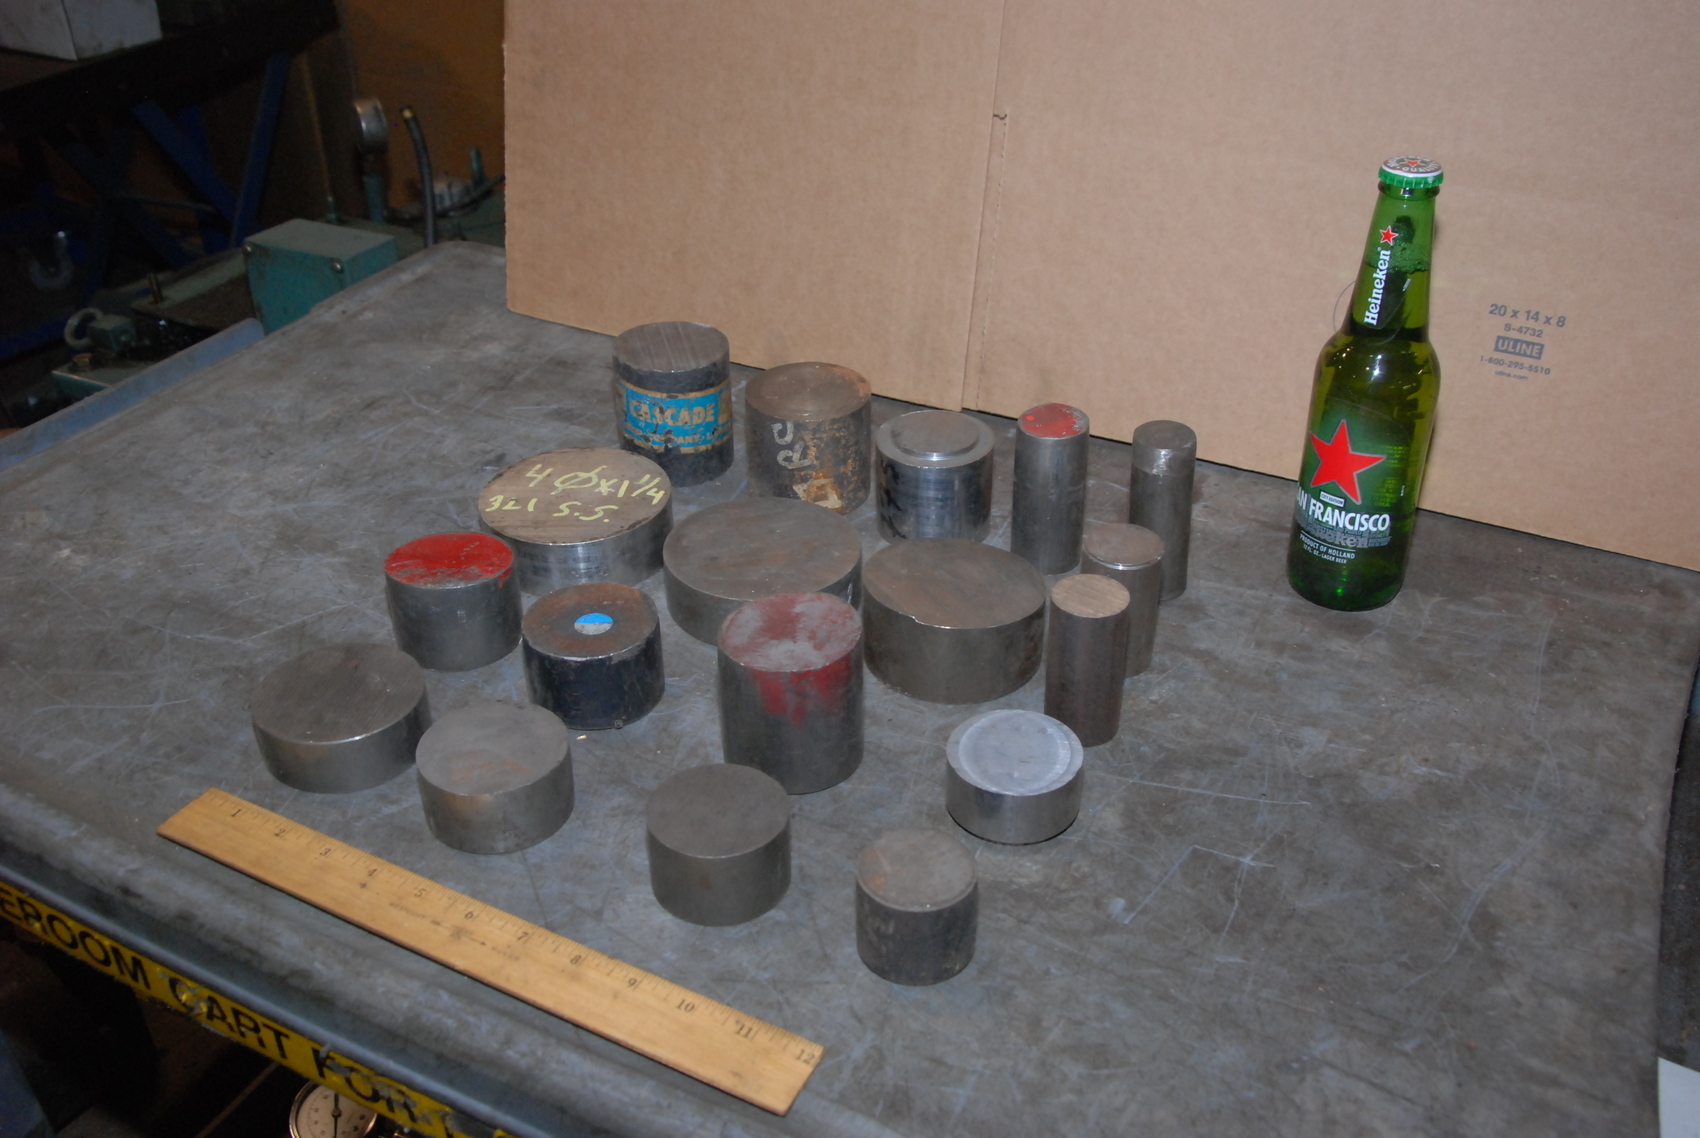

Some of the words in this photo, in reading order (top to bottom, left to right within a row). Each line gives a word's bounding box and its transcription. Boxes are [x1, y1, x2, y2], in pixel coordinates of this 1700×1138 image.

[1364, 249, 1391, 326] Heineken
[1488, 303, 1508, 317] 20
[1510, 309, 1520, 319] x
[1525, 309, 1540, 323] 14
[1542, 315, 1553, 326] x
[1556, 315, 1566, 328] 8
[1503, 323, 1544, 338] S-4732
[1497, 339, 1541, 357] ULINE
[1480, 355, 1551, 375] 1-800-295-5510
[630, 400, 715, 426] CASCADE
[525, 464, 553, 487] 4
[483, 494, 538, 512] 321
[1296, 486, 1307, 510] AN
[1309, 498, 1390, 531] FRANCISCO
[1300, 533, 1319, 549] PRODUCT
[1328, 548, 1355, 559] HOLLAND
[1321, 553, 1334, 562] LAGER
[231, 808, 242, 818] 1
[274, 828, 286, 838] 2
[320, 847, 331, 857] 3
[367, 867, 379, 877] 4
[415, 888, 427, 898] 5
[464, 911, 474, 919] 6
[517, 931, 529, 941] 7
[570, 954, 582, 965] 8
[627, 977, 638, 988] 9
[675, 999, 696, 1014] 10
[734, 1023, 754, 1039] 11
[795, 1048, 816, 1065] 12
[169, 978, 290, 1060] CART
